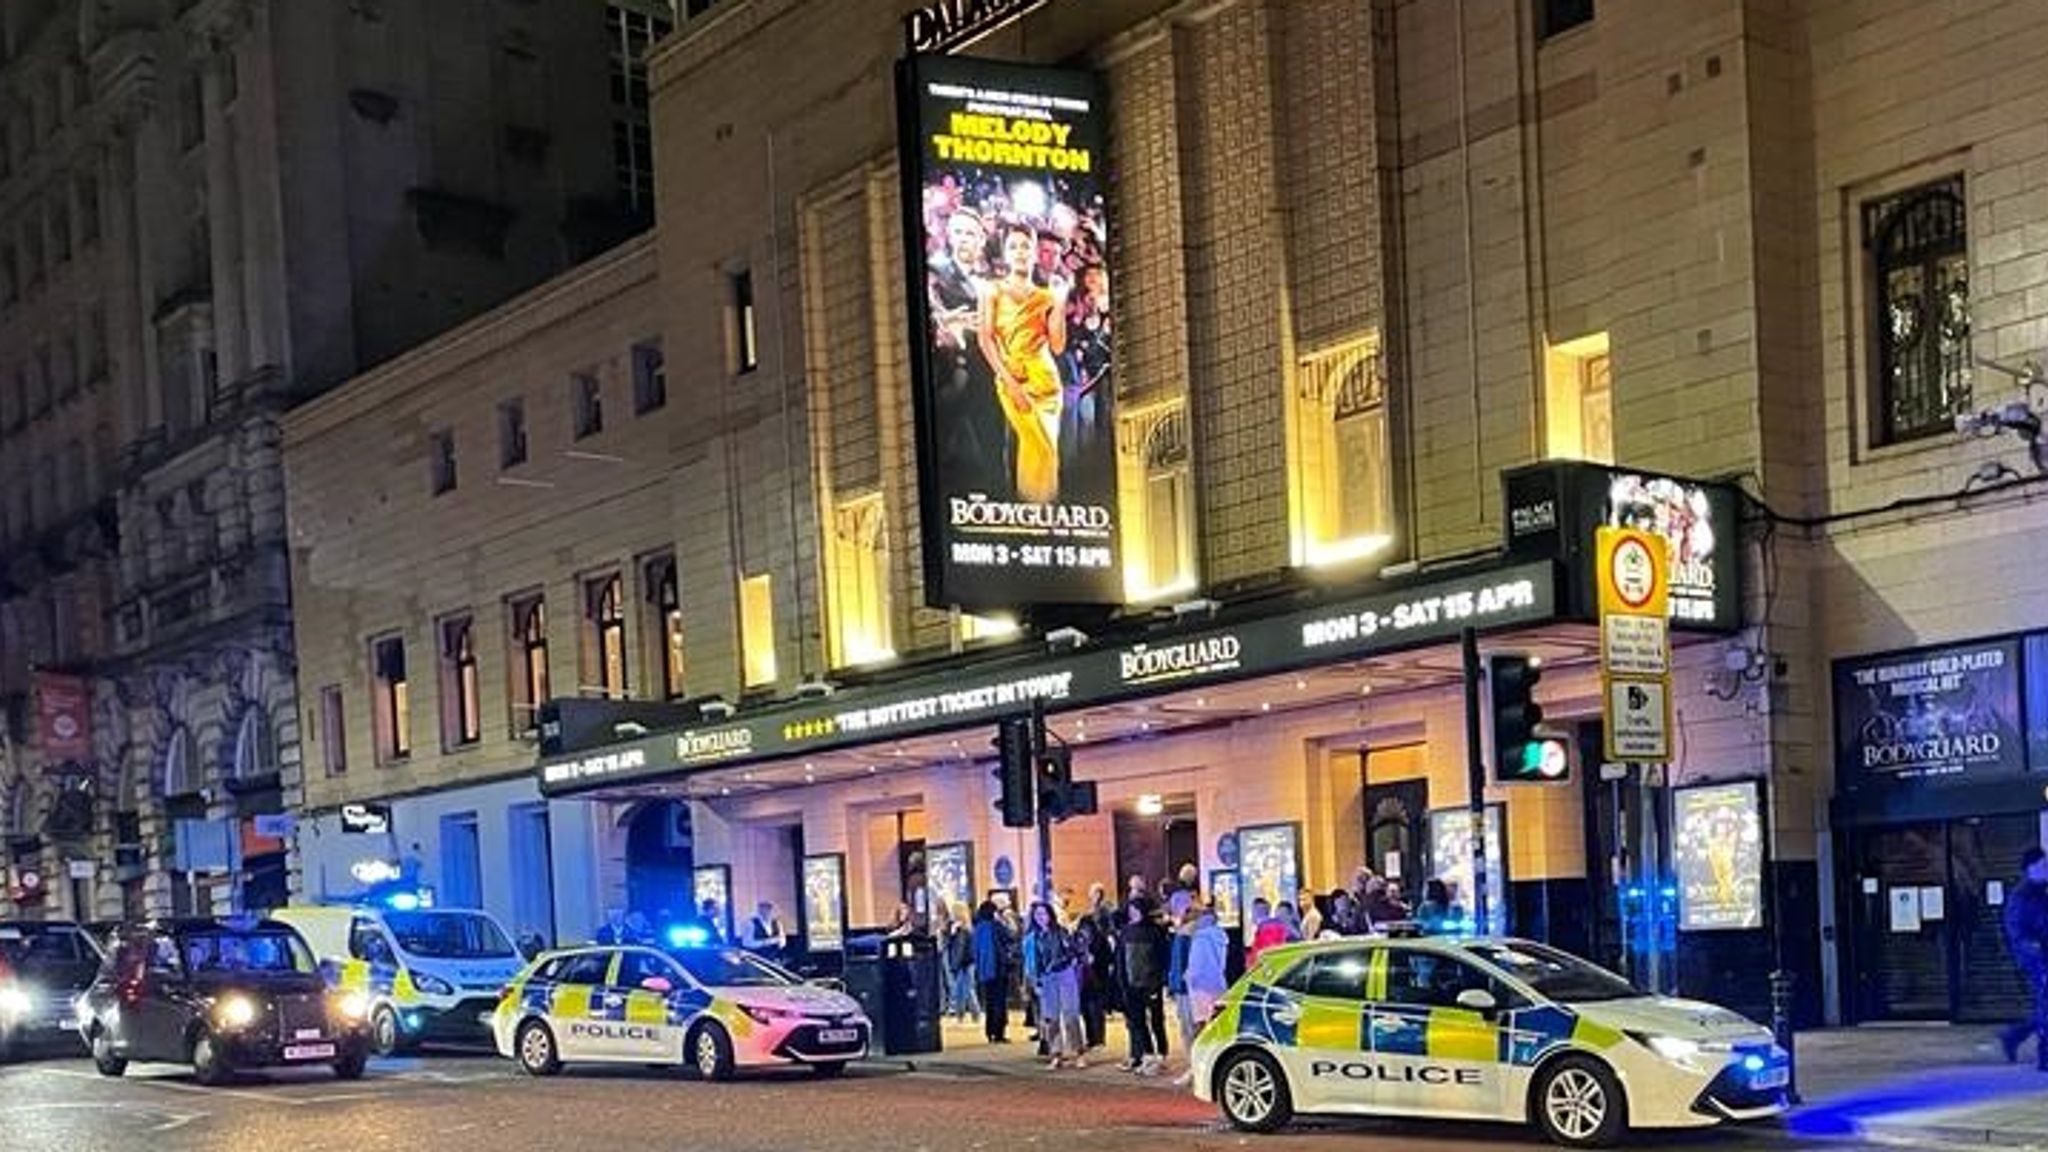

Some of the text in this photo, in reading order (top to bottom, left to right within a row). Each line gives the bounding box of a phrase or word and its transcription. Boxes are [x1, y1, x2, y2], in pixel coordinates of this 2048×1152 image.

[951, 113, 1071, 146] MELODY
[933, 134, 1090, 173] THORNTON
[952, 544, 993, 564] MON
[997, 544, 1008, 565] 3
[1020, 545, 1052, 567] SAT
[1056, 546, 1075, 567] 15
[1079, 547, 1111, 568] APR
[1302, 615, 1357, 647] MON
[1360, 611, 1378, 636] 3
[1392, 597, 1440, 630] SAT
[1443, 591, 1473, 619] 15
[1477, 580, 1534, 613] APR
[869, 698, 937, 726] HOTTEST
[941, 687, 995, 714] TICKET
[997, 684, 1014, 703] IN
[1863, 733, 2000, 767] BODYGUARD
[571, 1022, 662, 1040] POLICE
[1311, 1061, 1483, 1085] POLICE
